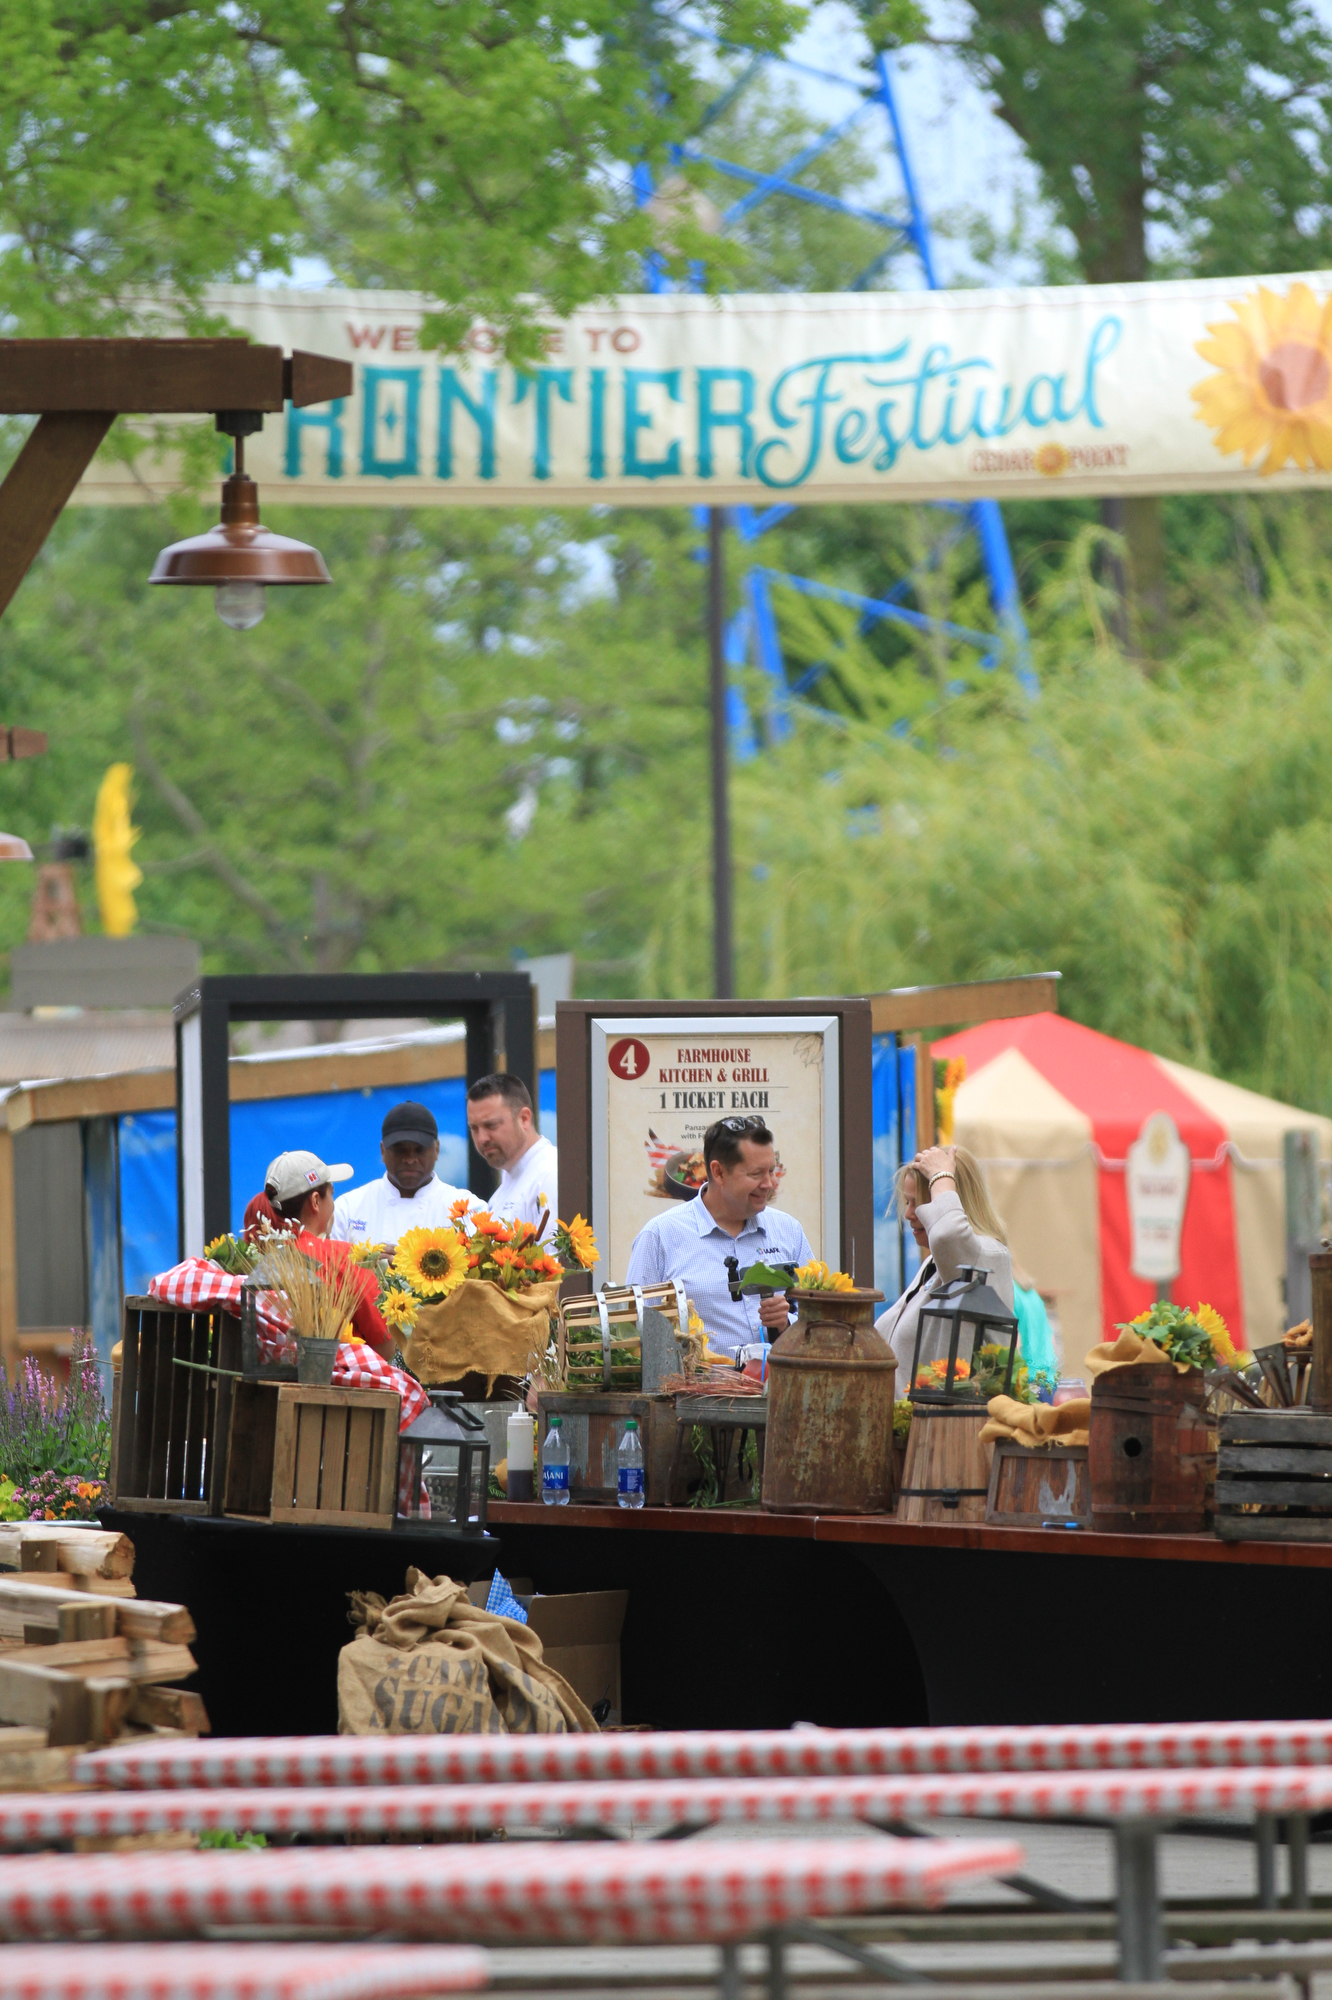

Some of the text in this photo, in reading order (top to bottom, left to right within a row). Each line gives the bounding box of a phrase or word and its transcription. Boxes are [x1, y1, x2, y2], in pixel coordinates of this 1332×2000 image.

[346, 322, 642, 355] WEOE TO
[222, 314, 1123, 490] RONTIER Festival
[619, 1044, 638, 1075] 4
[677, 1048, 751, 1063] FARMHOUSE
[659, 1067, 770, 1083] KITCHEN & GRILL
[659, 1091, 769, 1109] 1 TICKET EACH
[543, 1470, 564, 1481] ASANI
